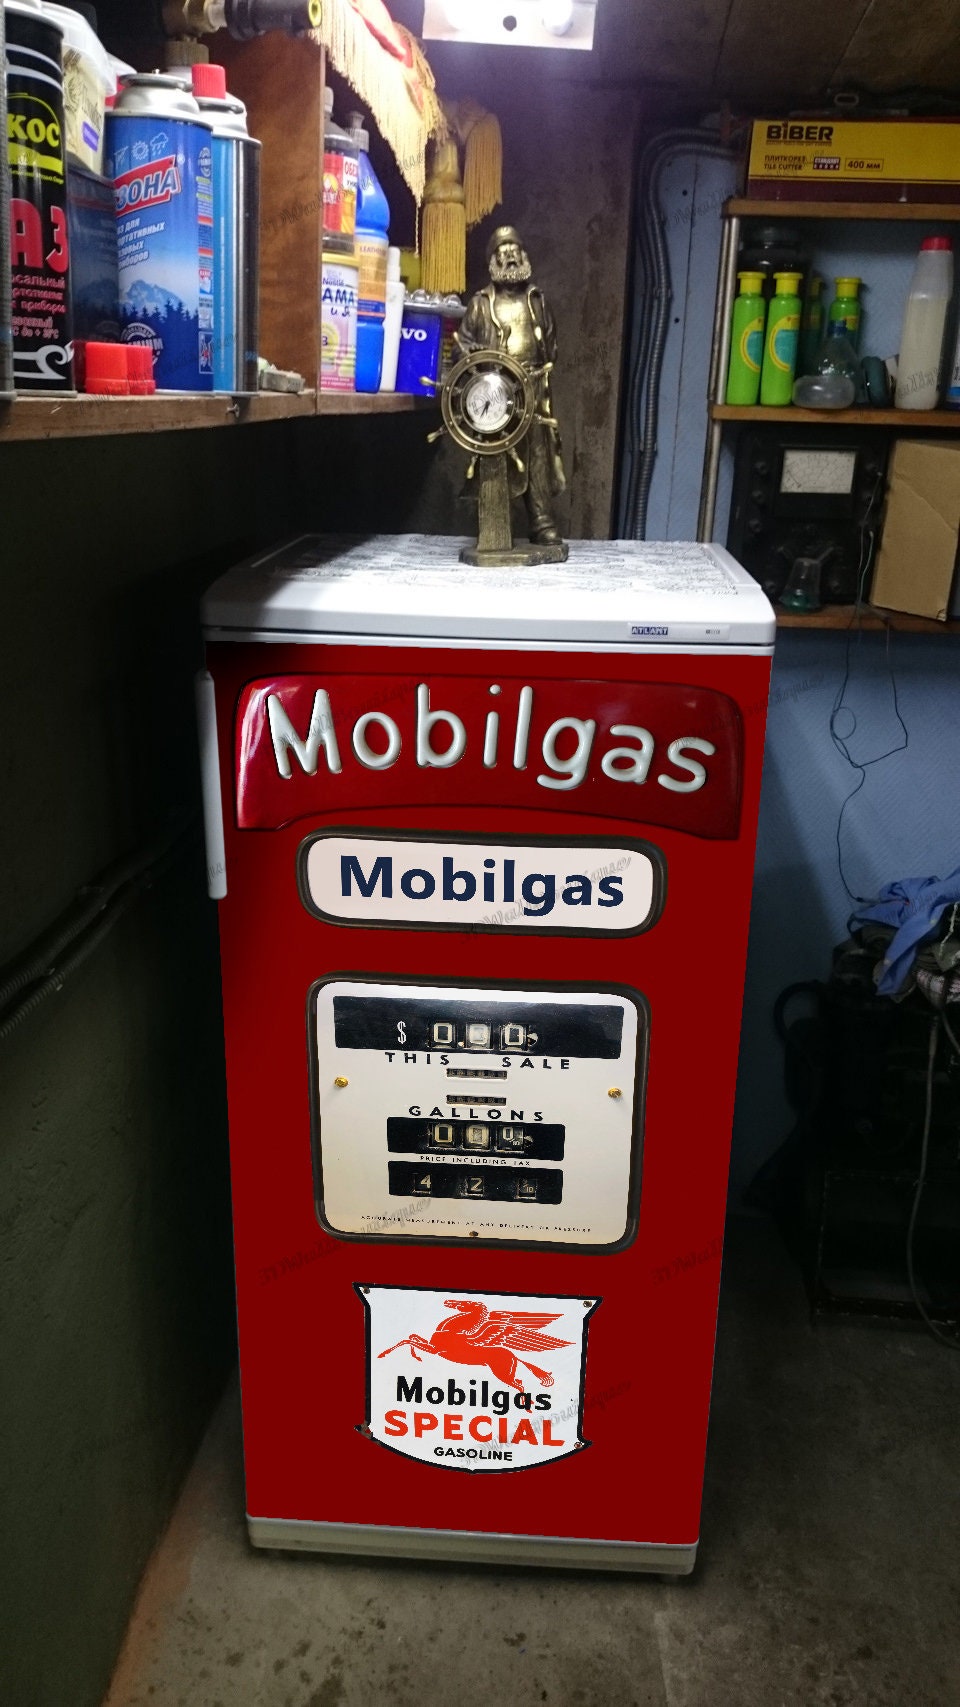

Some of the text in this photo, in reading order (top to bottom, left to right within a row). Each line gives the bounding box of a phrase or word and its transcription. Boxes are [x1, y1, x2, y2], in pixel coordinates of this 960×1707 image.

[847, 160, 864, 169] 400
[267, 684, 717, 793] Mobilgas
[341, 855, 624, 917] Mobilgas
[385, 1052, 570, 1070] THIS SALE
[408, 1105, 544, 1122] GALLONS
[397, 1376, 552, 1416] Mobilgas
[385, 1410, 566, 1447] SPECIAL
[434, 1446, 513, 1462] GASOLINE
